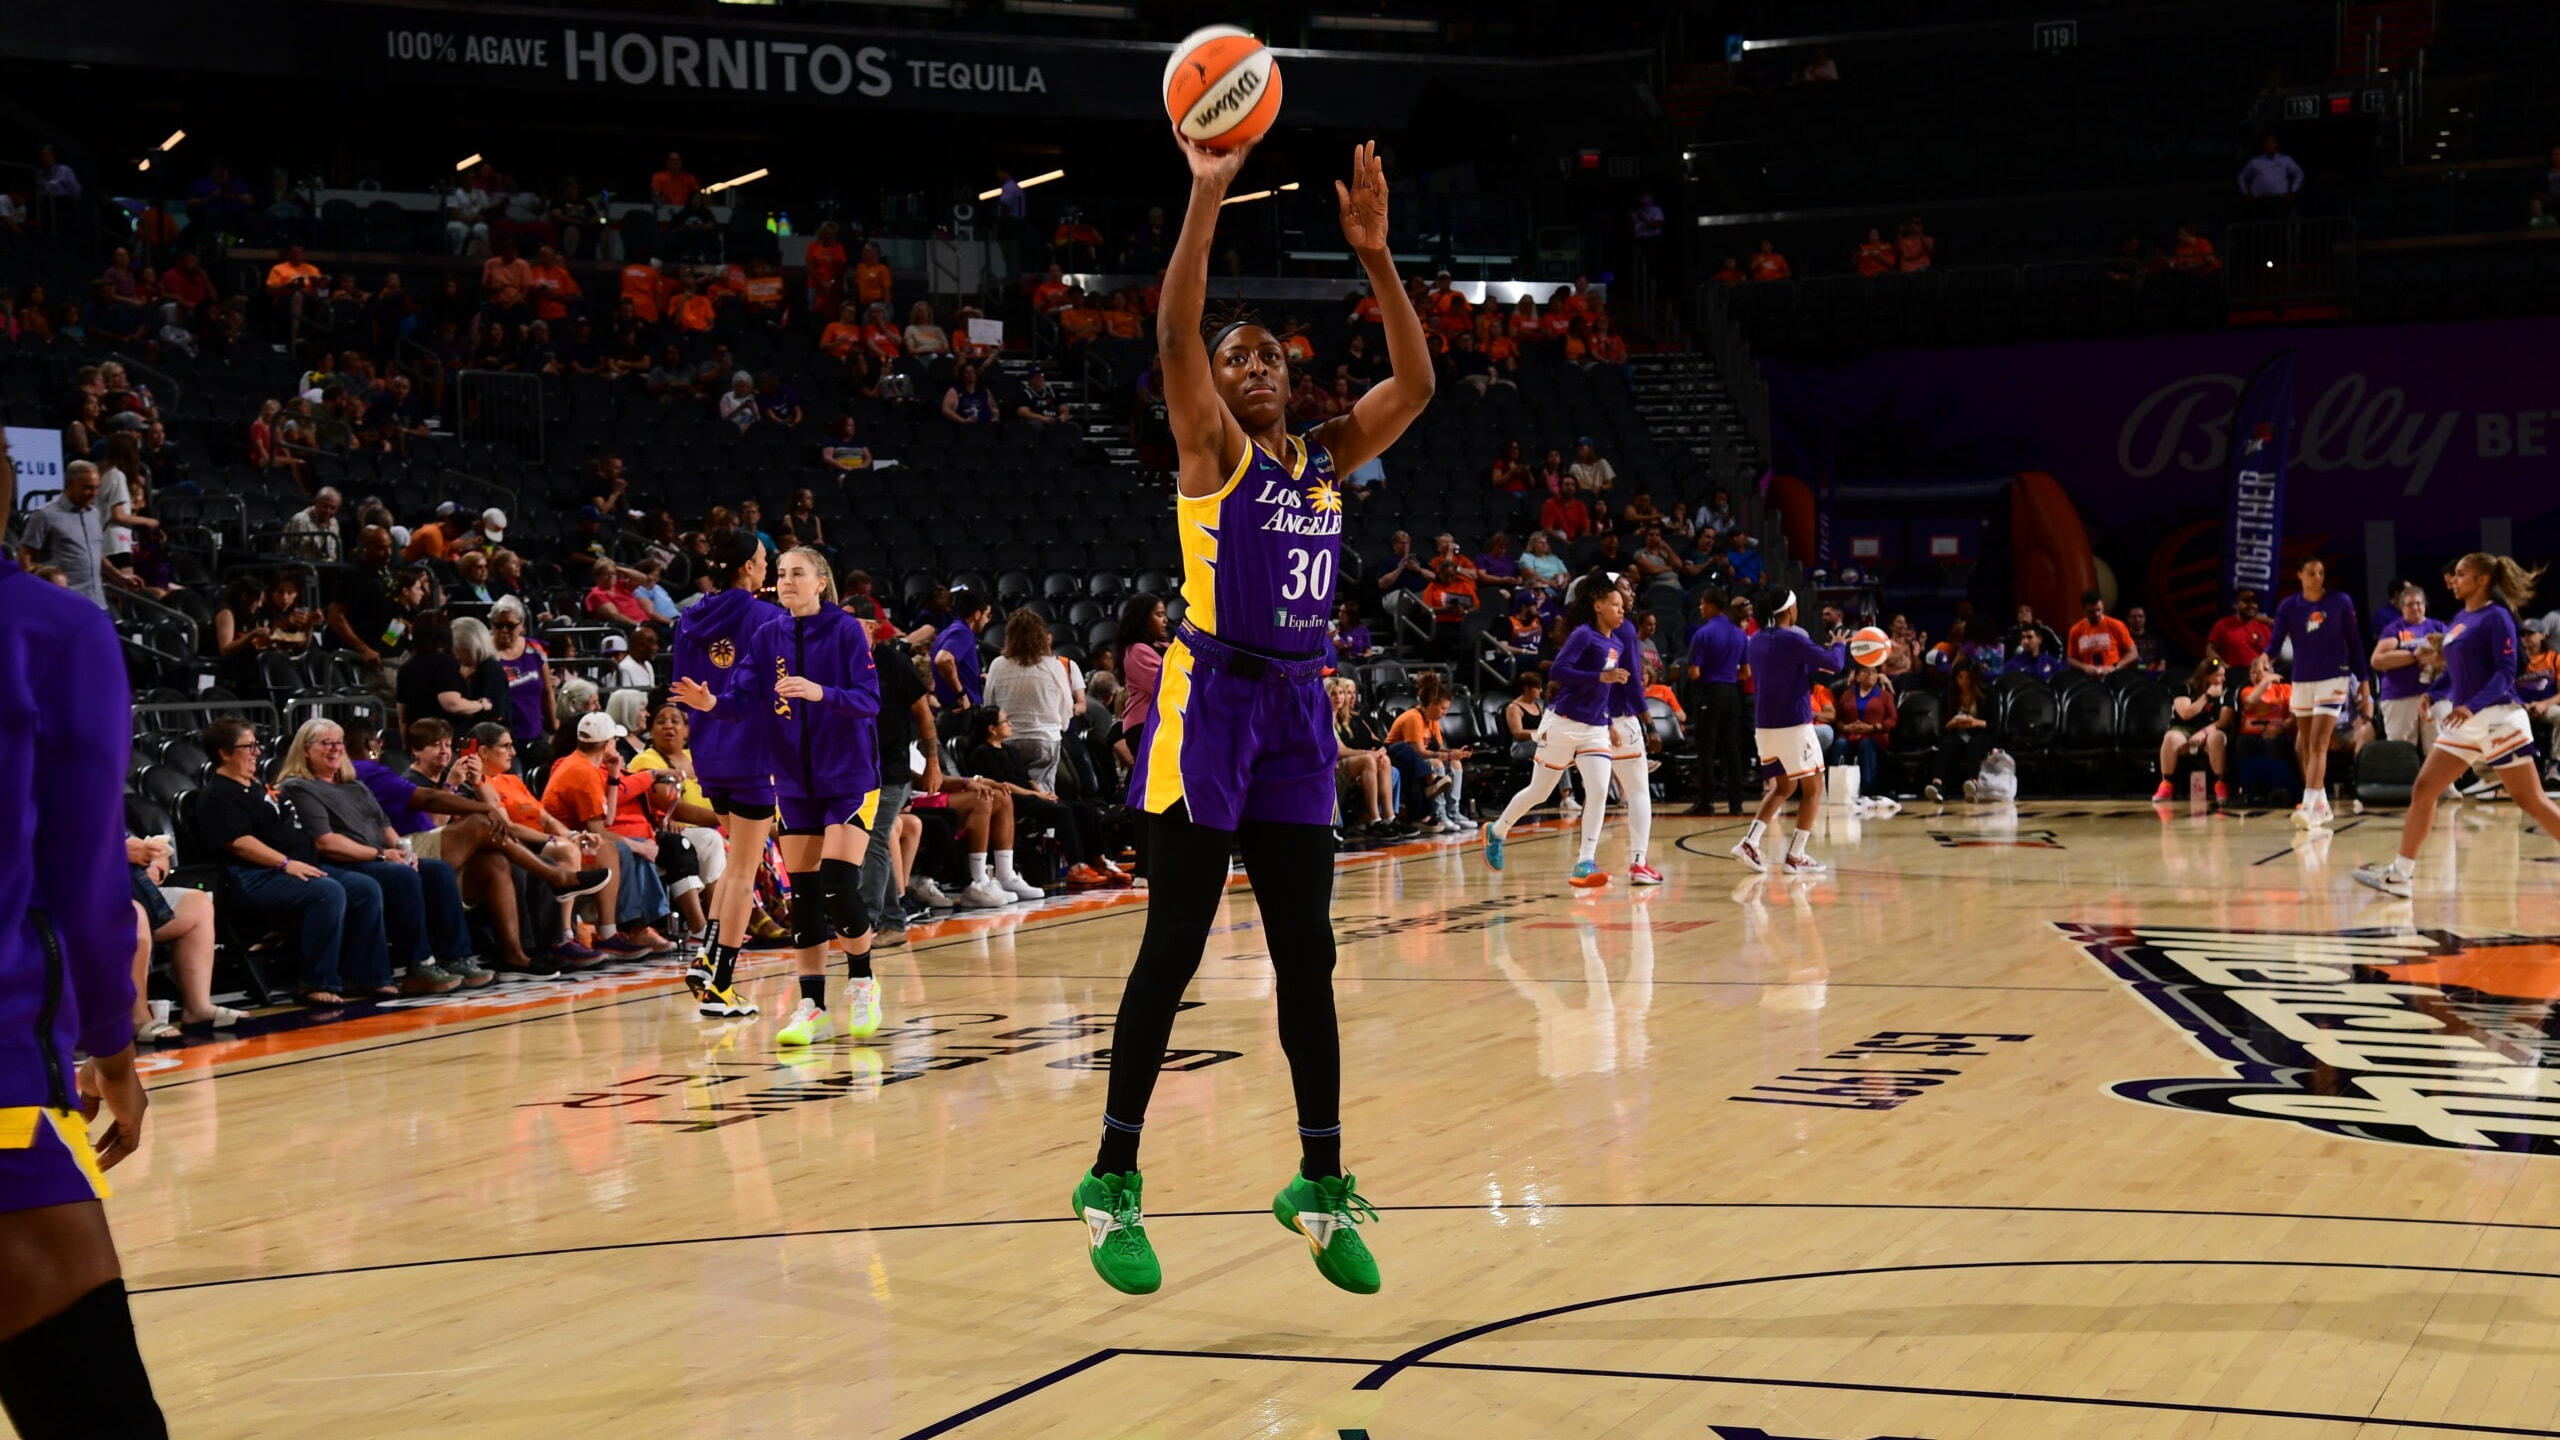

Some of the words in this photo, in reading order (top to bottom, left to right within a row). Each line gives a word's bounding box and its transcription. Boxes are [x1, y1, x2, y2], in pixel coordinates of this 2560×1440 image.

[387, 31, 457, 62] 100%
[464, 36, 549, 68] AGAVE
[564, 29, 893, 97] HORNITOS
[907, 60, 1047, 95] TEQUILA
[2042, 28, 2070, 48] 119
[1195, 69, 1259, 128] Wilson
[2117, 373, 2461, 497] Blly
[15, 461, 56, 475] CLUB
[2233, 470, 2276, 591] TOGETHER
[1281, 548, 1333, 601] 30
[627, 1001, 1207, 1134] OOTPRINT
[1824, 1031, 2036, 1060] Est.
[1725, 1068, 1963, 1111] 1997
